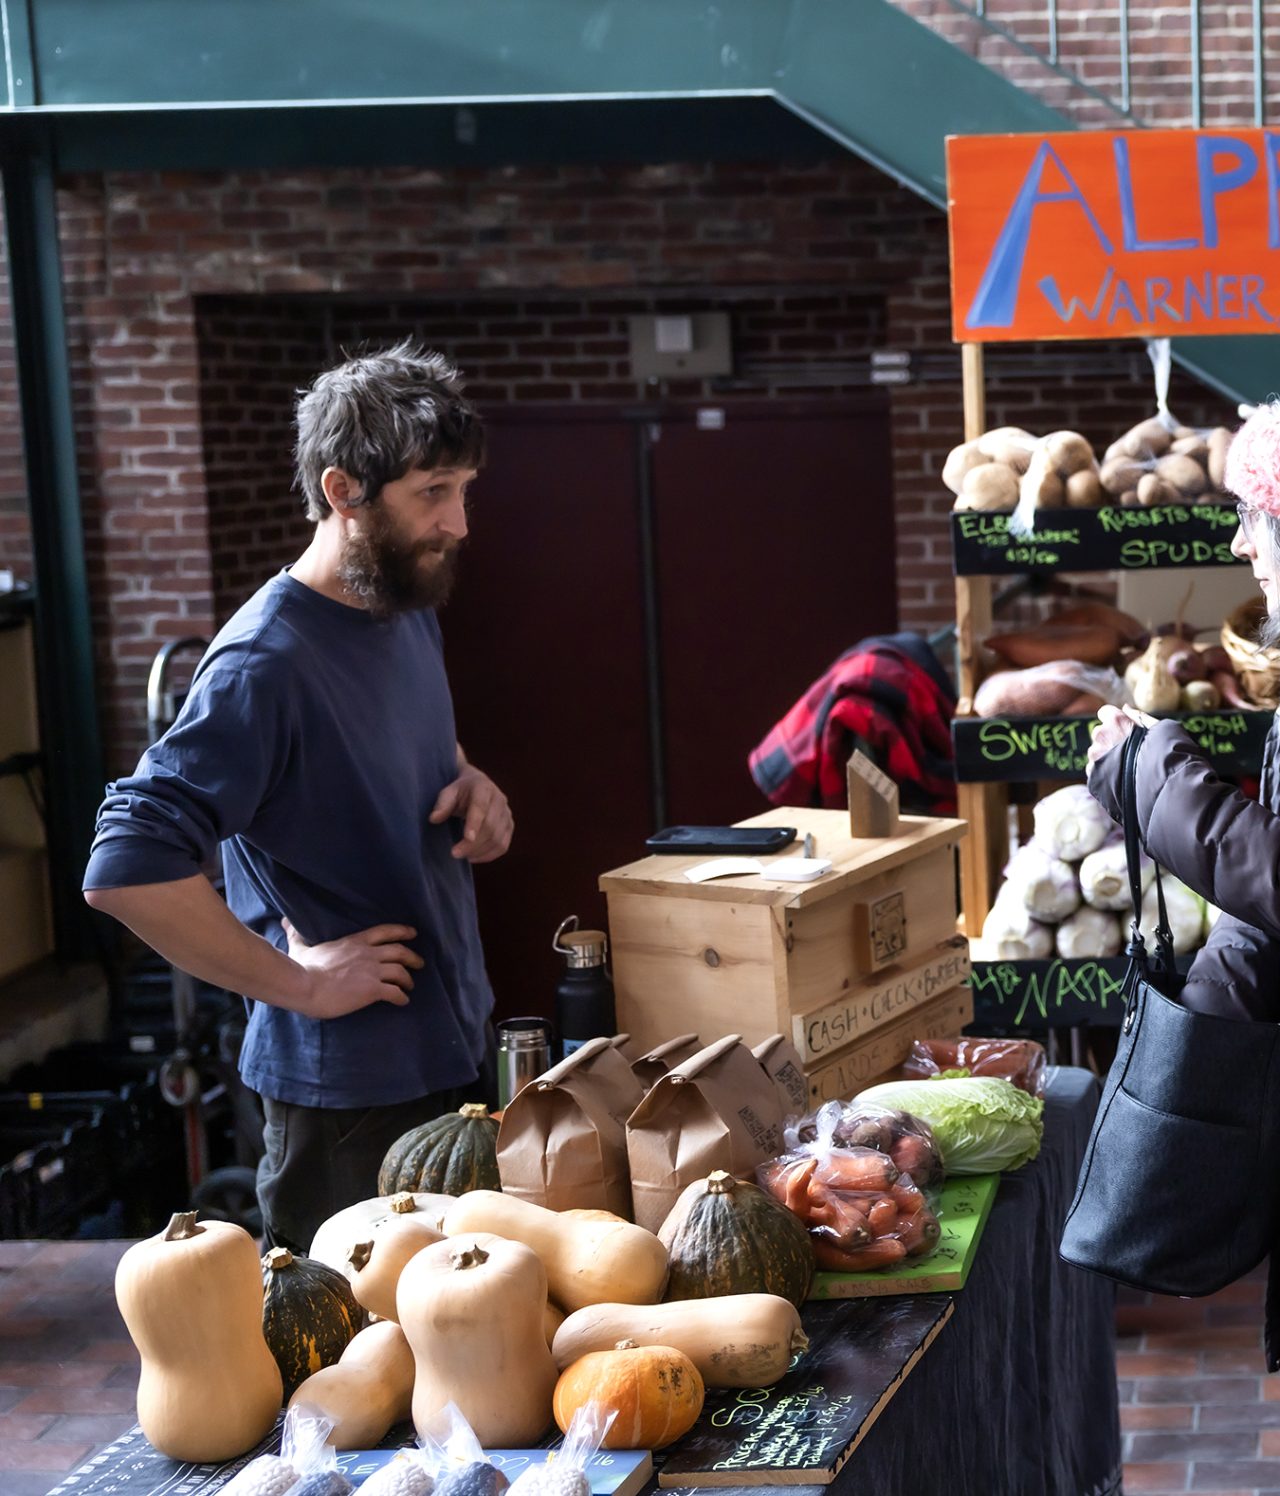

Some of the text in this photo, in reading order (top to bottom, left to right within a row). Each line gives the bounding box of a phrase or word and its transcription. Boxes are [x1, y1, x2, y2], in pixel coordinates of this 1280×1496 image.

[1098, 506, 1190, 532] RUSSETS
[1119, 538, 1236, 567] SPUDS
[979, 719, 1082, 761] SWEET
[1014, 959, 1129, 1025] NAPA
[808, 1006, 859, 1053] CASH
[870, 981, 918, 1021] CHECK
